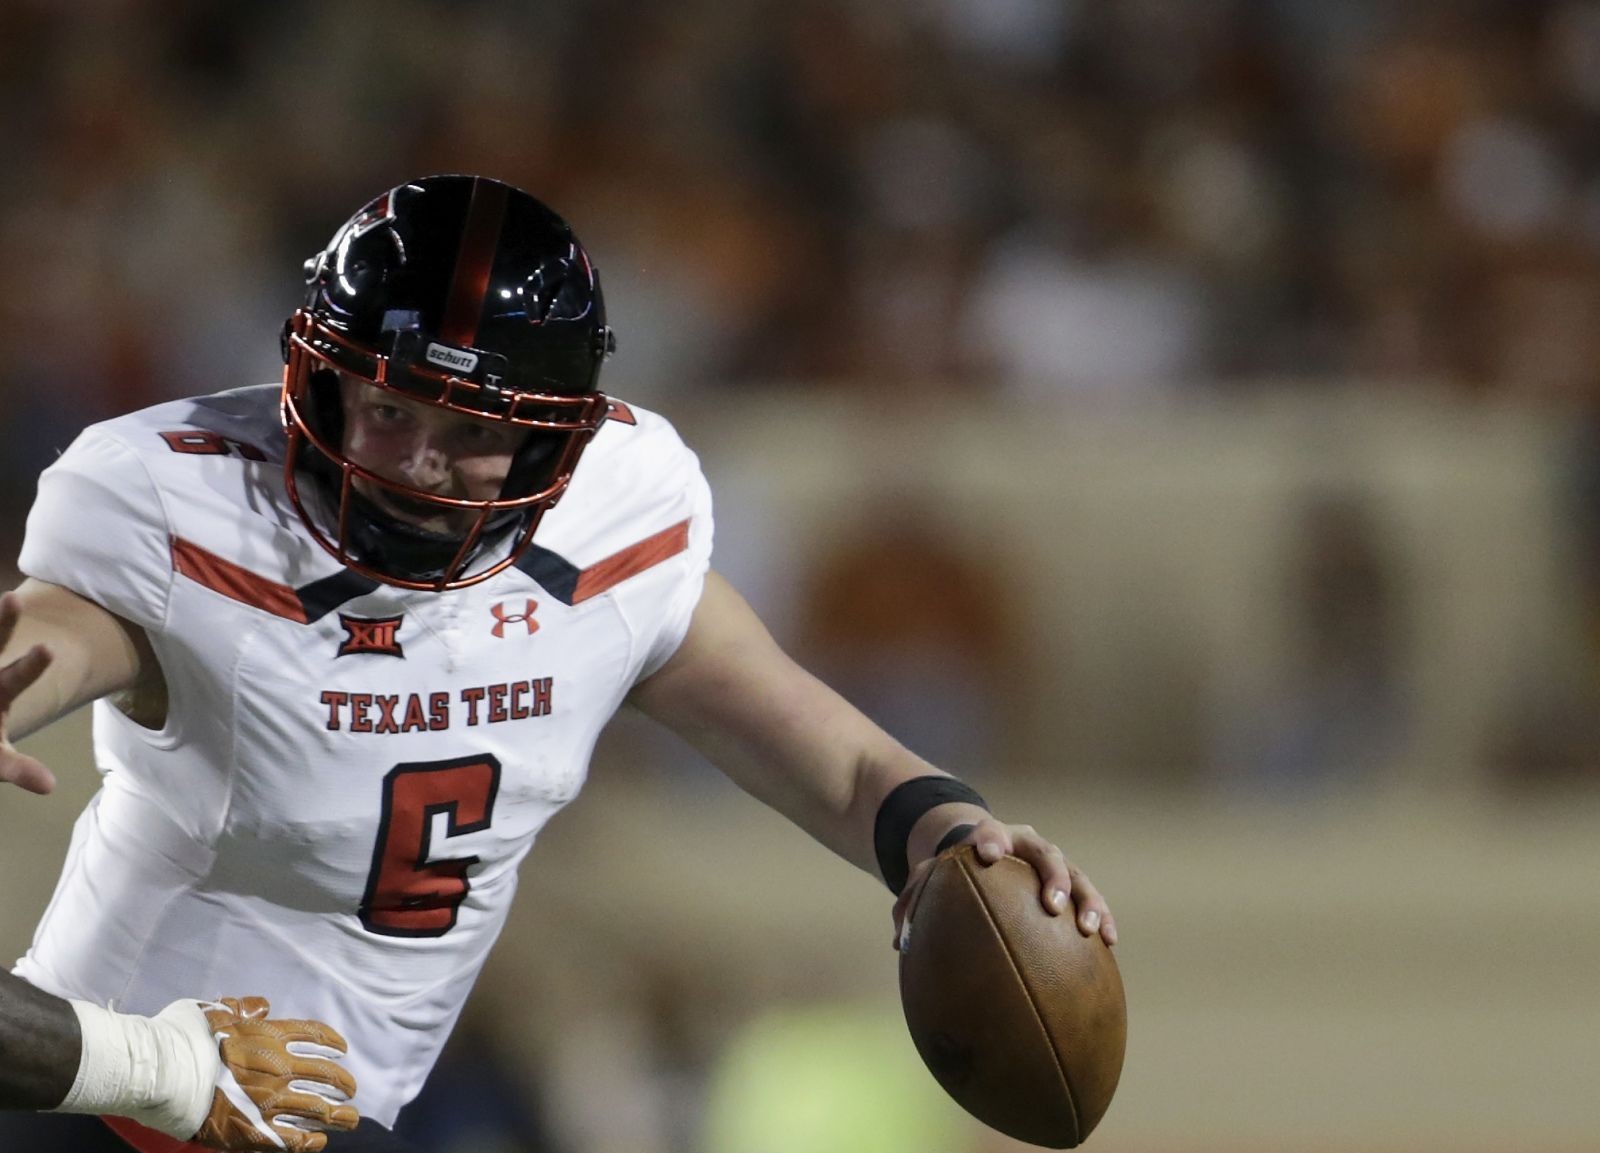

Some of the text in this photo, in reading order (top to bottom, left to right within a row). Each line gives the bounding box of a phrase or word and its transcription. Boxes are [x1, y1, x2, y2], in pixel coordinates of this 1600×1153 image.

[429, 348, 473, 368] schutt
[320, 677, 554, 734] TEXAS TECH
[357, 752, 502, 938] 6
